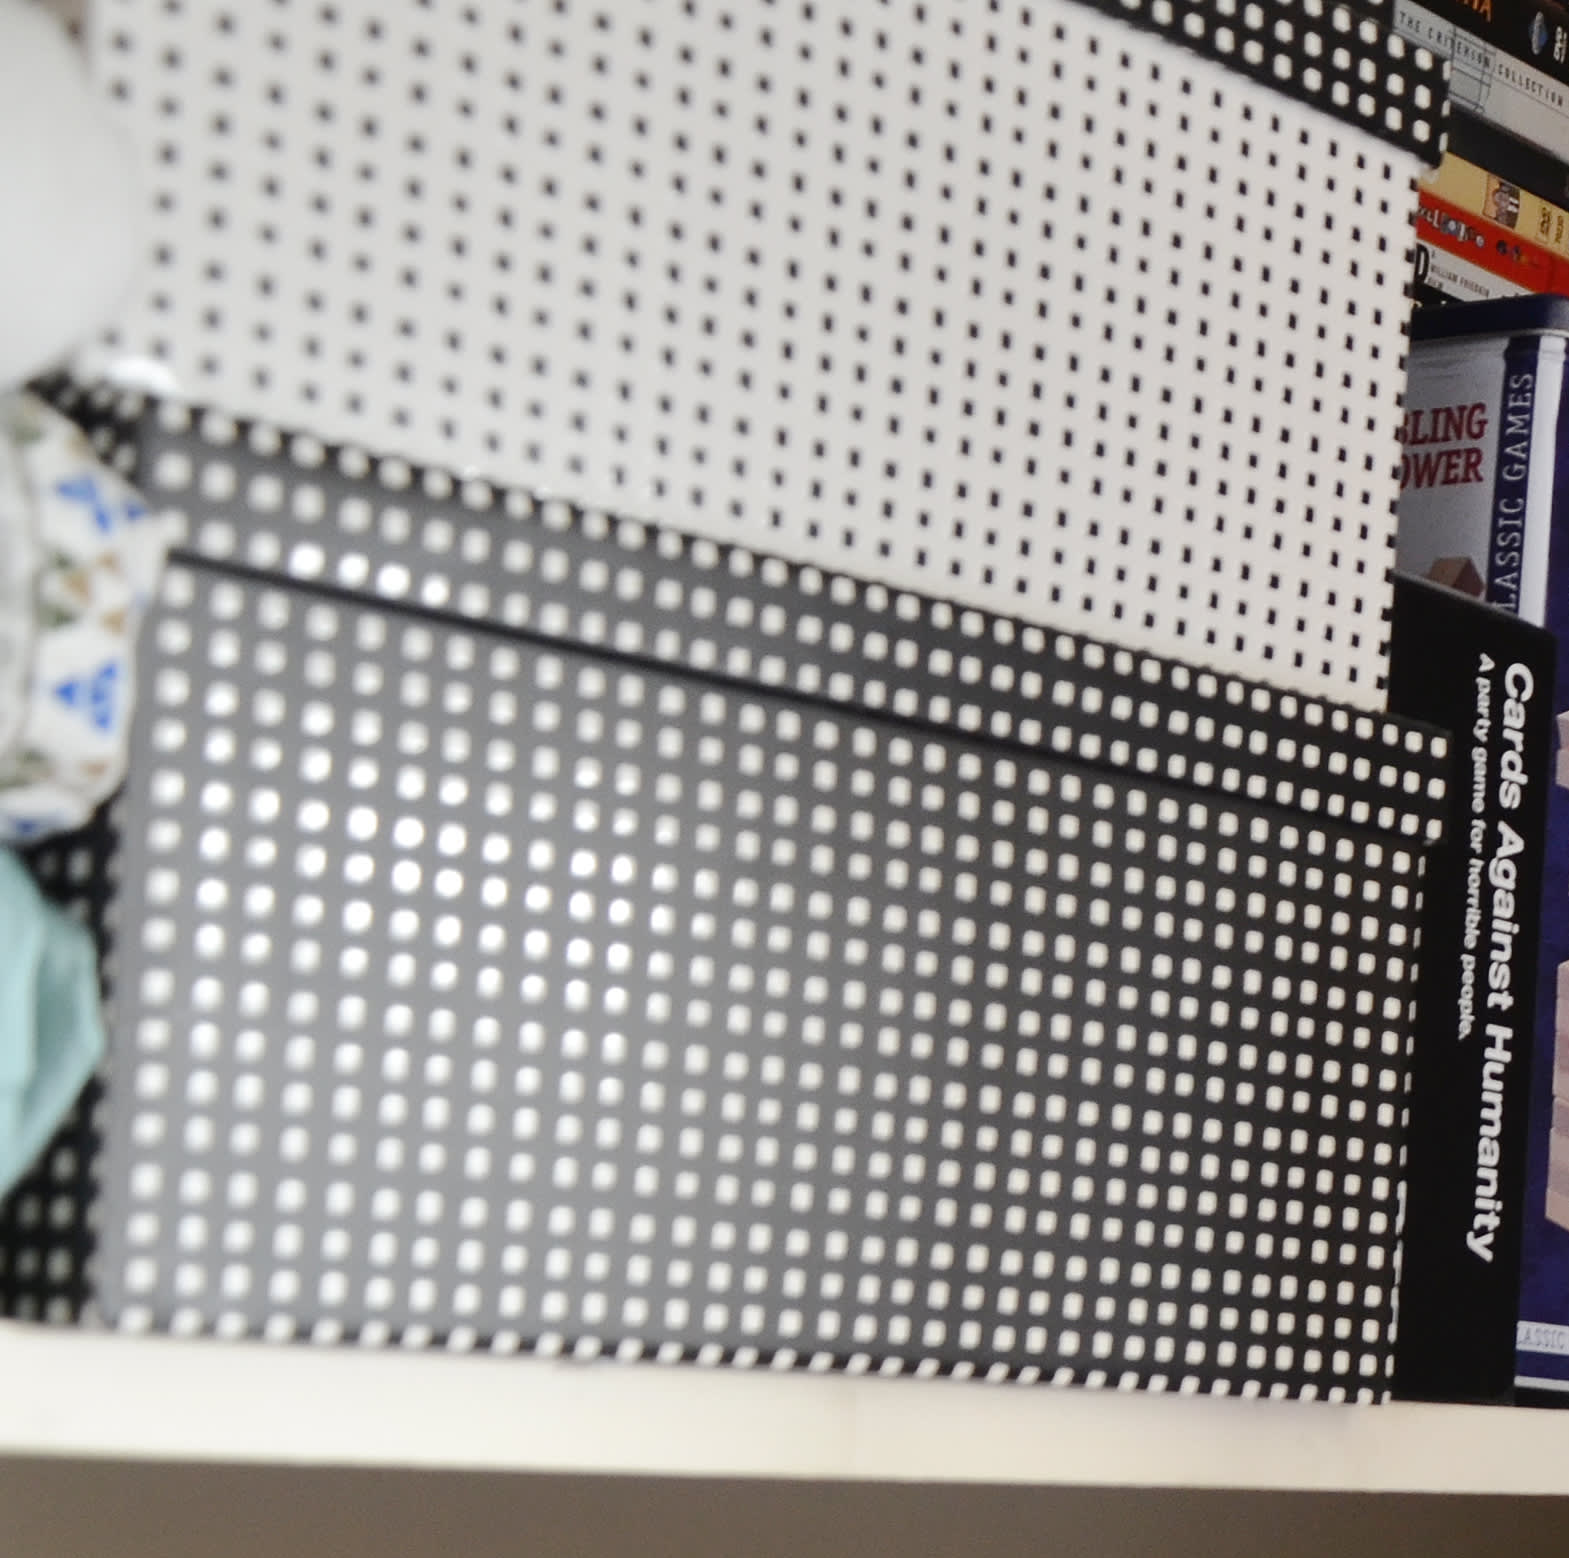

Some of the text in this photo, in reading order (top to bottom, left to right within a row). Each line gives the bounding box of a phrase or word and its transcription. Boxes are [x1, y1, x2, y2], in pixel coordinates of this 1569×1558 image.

[1502, 373, 1534, 481] GAMES
[1457, 652, 1496, 1041] A party game for horrible people.
[1466, 662, 1534, 1262] Cards Against Humanity
